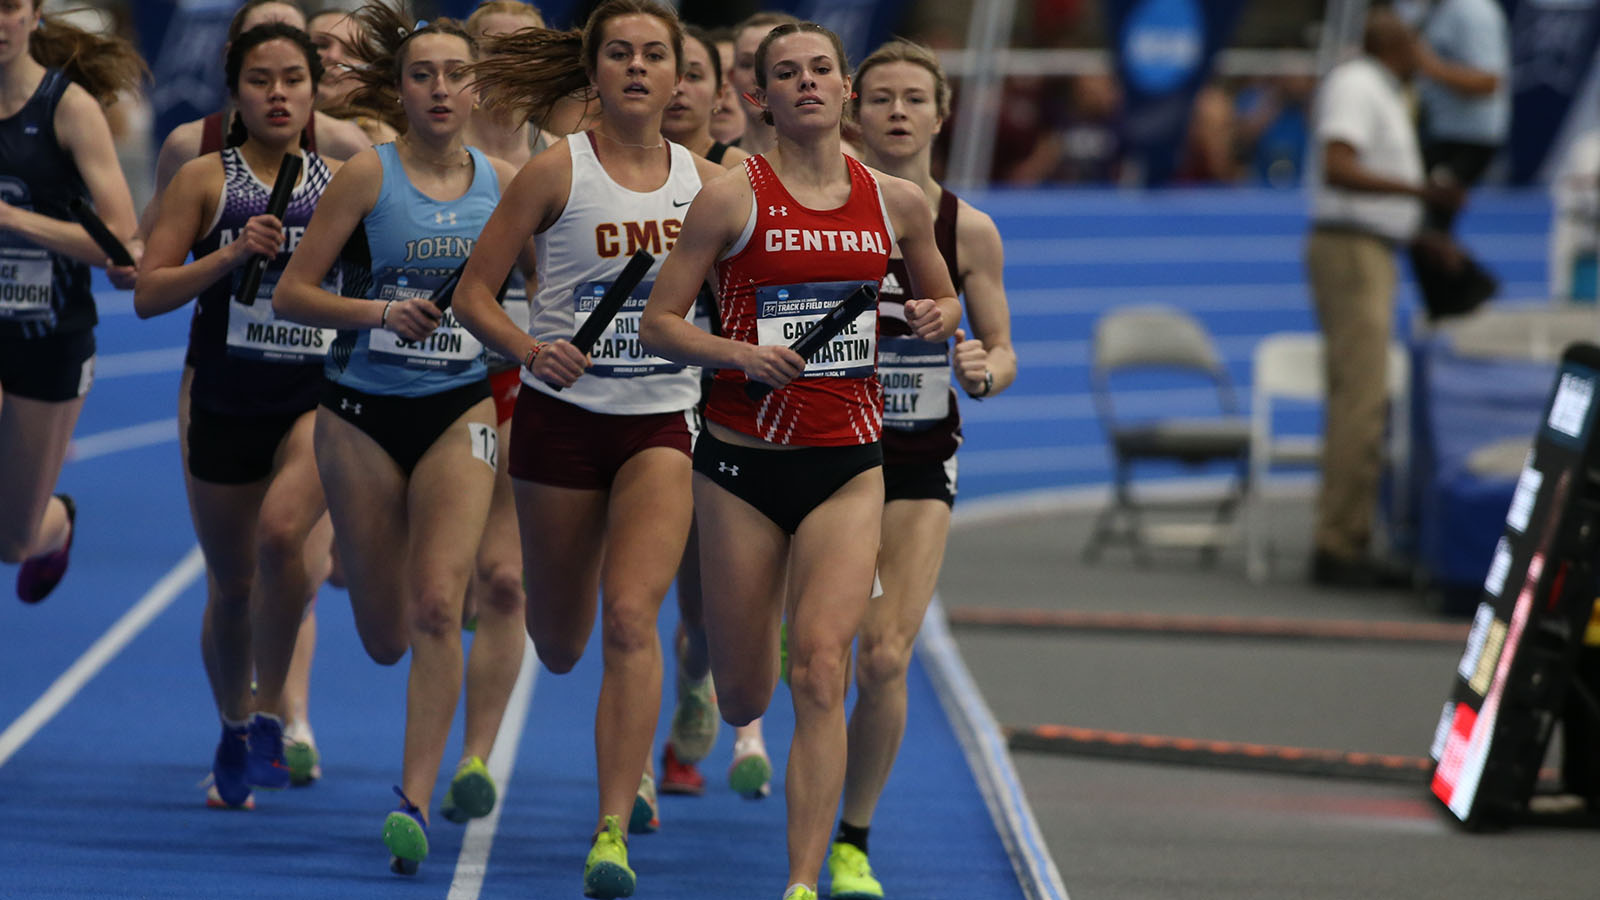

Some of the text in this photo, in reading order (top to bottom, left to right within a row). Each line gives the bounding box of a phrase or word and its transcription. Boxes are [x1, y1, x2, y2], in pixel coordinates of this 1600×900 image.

[595, 219, 682, 258] CMS
[765, 228, 887, 255] CENTRAL
[0, 283, 49, 304] OUGH
[778, 302, 799, 312] TRACK
[805, 301, 823, 310] FIELD
[246, 323, 324, 348] MARCUS
[615, 317, 641, 334] RIL
[783, 319, 858, 340] CARNE
[591, 338, 656, 359] CAPU
[883, 393, 919, 413] ELLY
